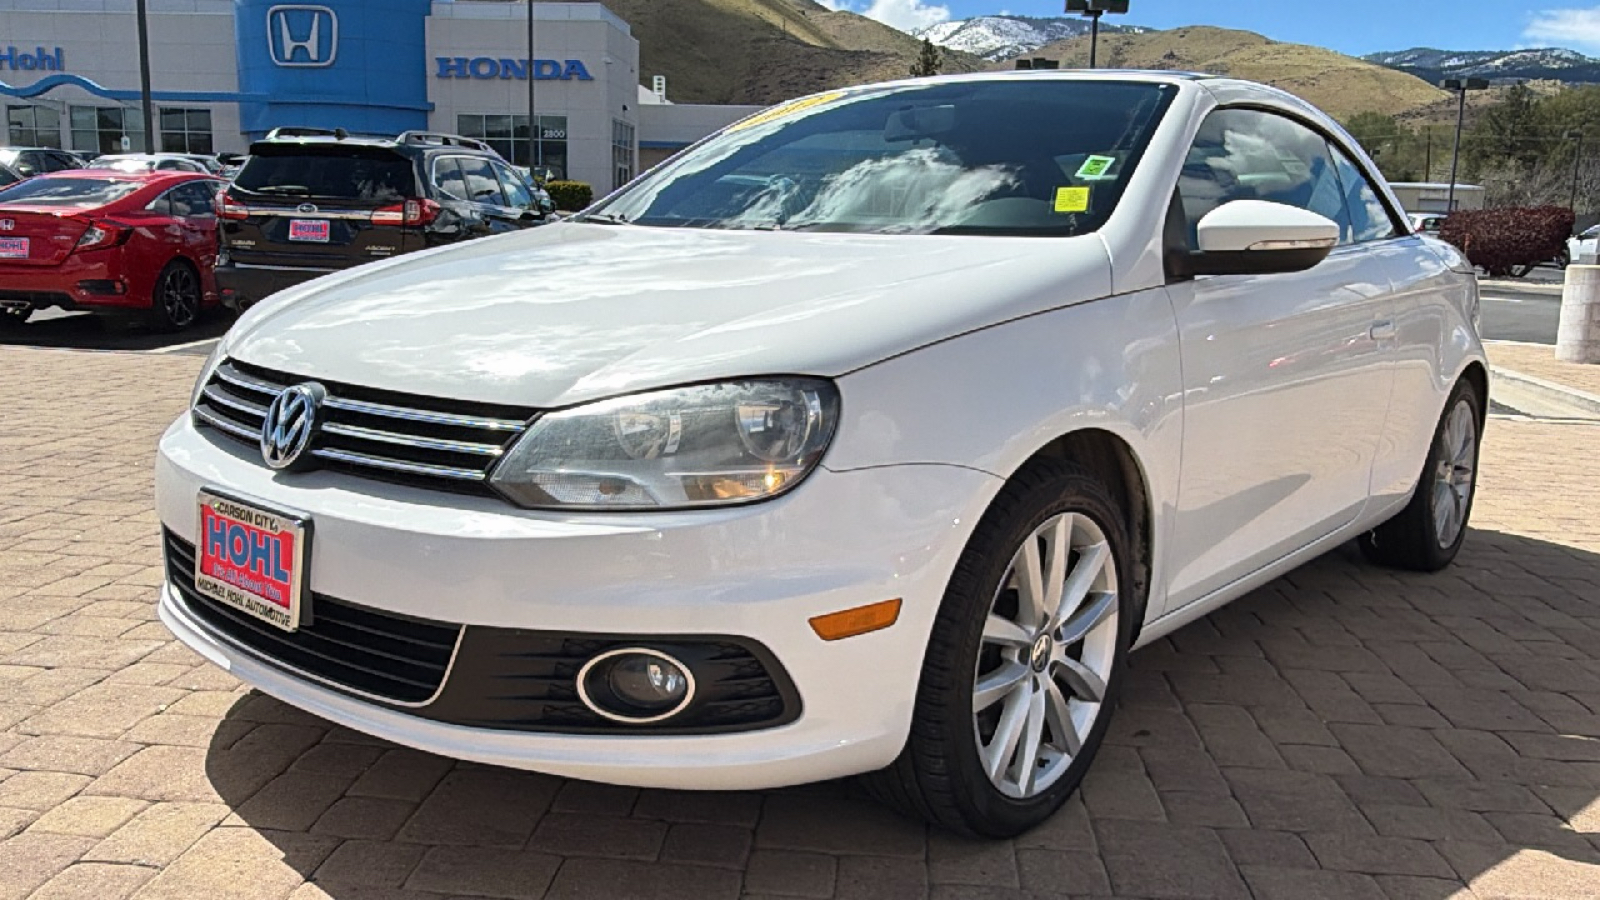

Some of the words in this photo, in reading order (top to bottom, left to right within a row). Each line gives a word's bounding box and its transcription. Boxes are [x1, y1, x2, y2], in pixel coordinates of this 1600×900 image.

[435, 57, 594, 81] HONDA
[219, 502, 253, 523] CARSON
[207, 515, 290, 585] HOHL
[197, 577, 226, 598] MICHAEL
[245, 598, 291, 627] AUTOMOTIVE
